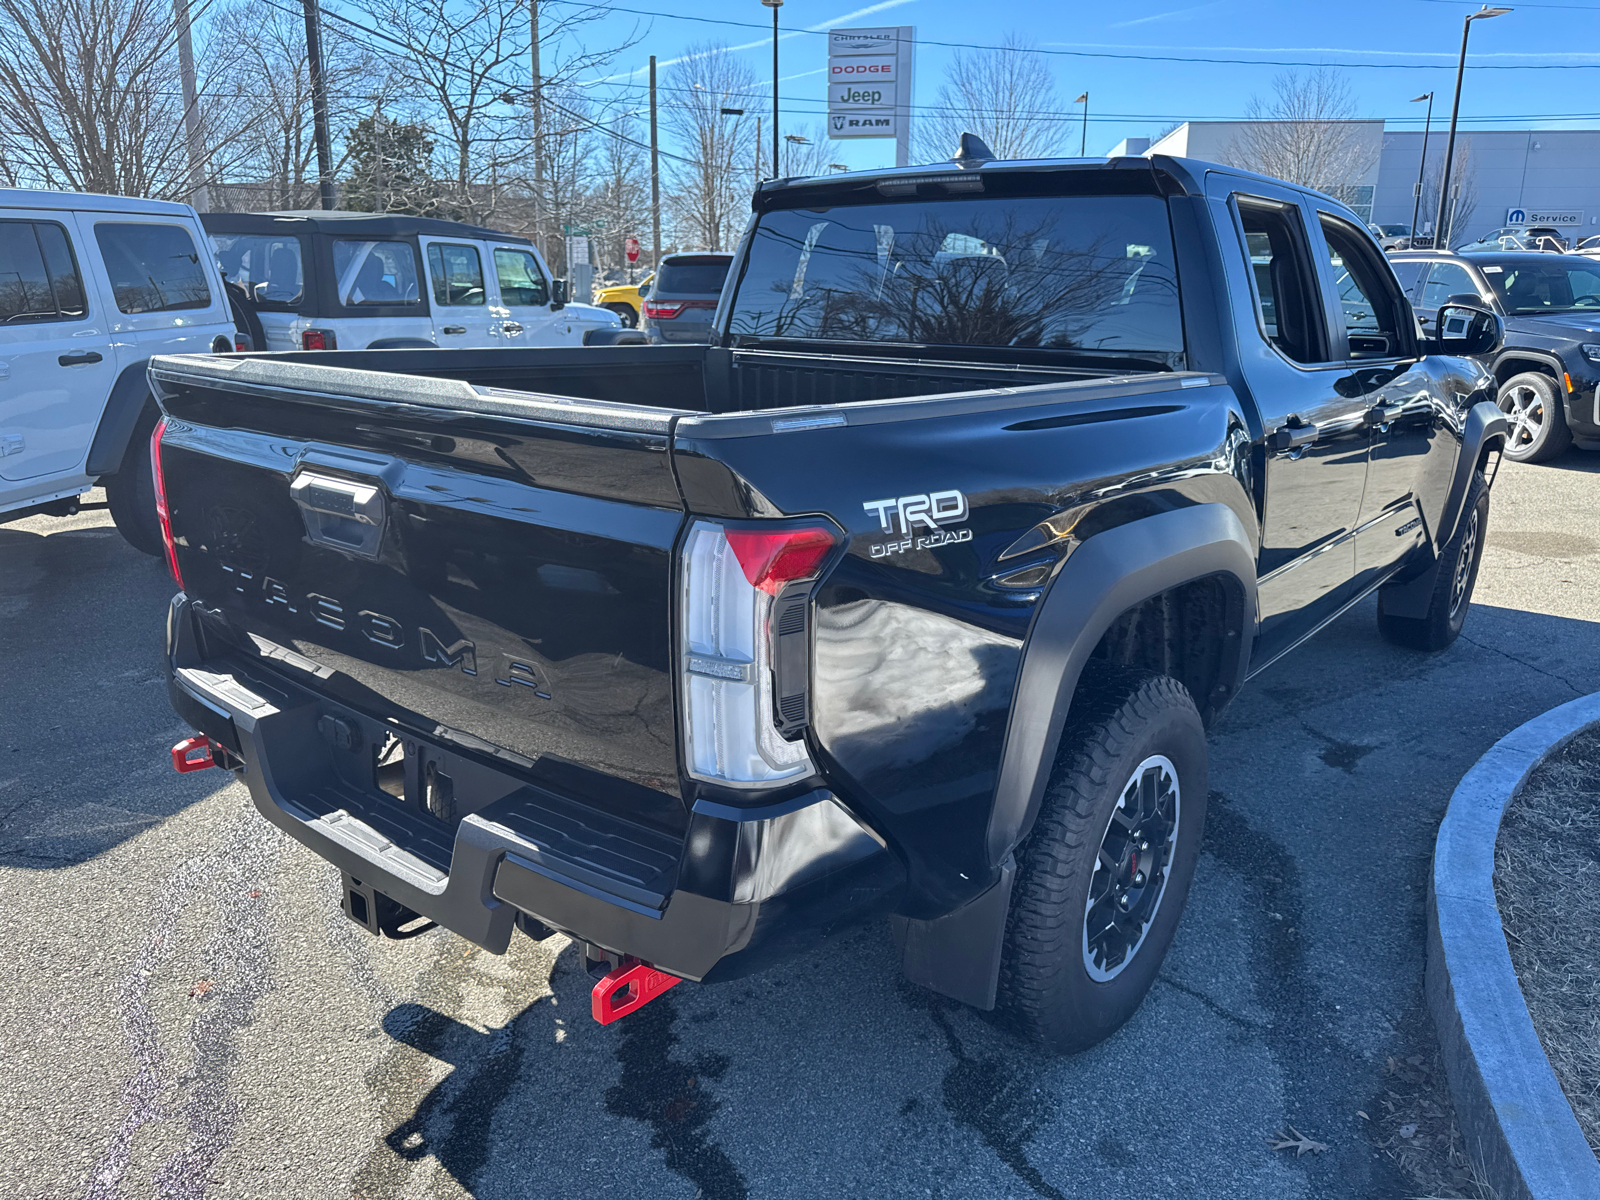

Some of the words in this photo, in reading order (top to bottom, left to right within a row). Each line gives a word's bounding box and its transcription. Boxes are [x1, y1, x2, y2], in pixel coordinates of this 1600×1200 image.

[832, 65, 891, 74] DODGE
[840, 87, 882, 105] Jeep
[849, 119, 890, 127] RAM
[1530, 214, 1576, 222] Service
[862, 489, 969, 540] TRD
[868, 539, 913, 558] OFF
[916, 528, 974, 550] ROAD
[219, 560, 552, 700] TACOMA
